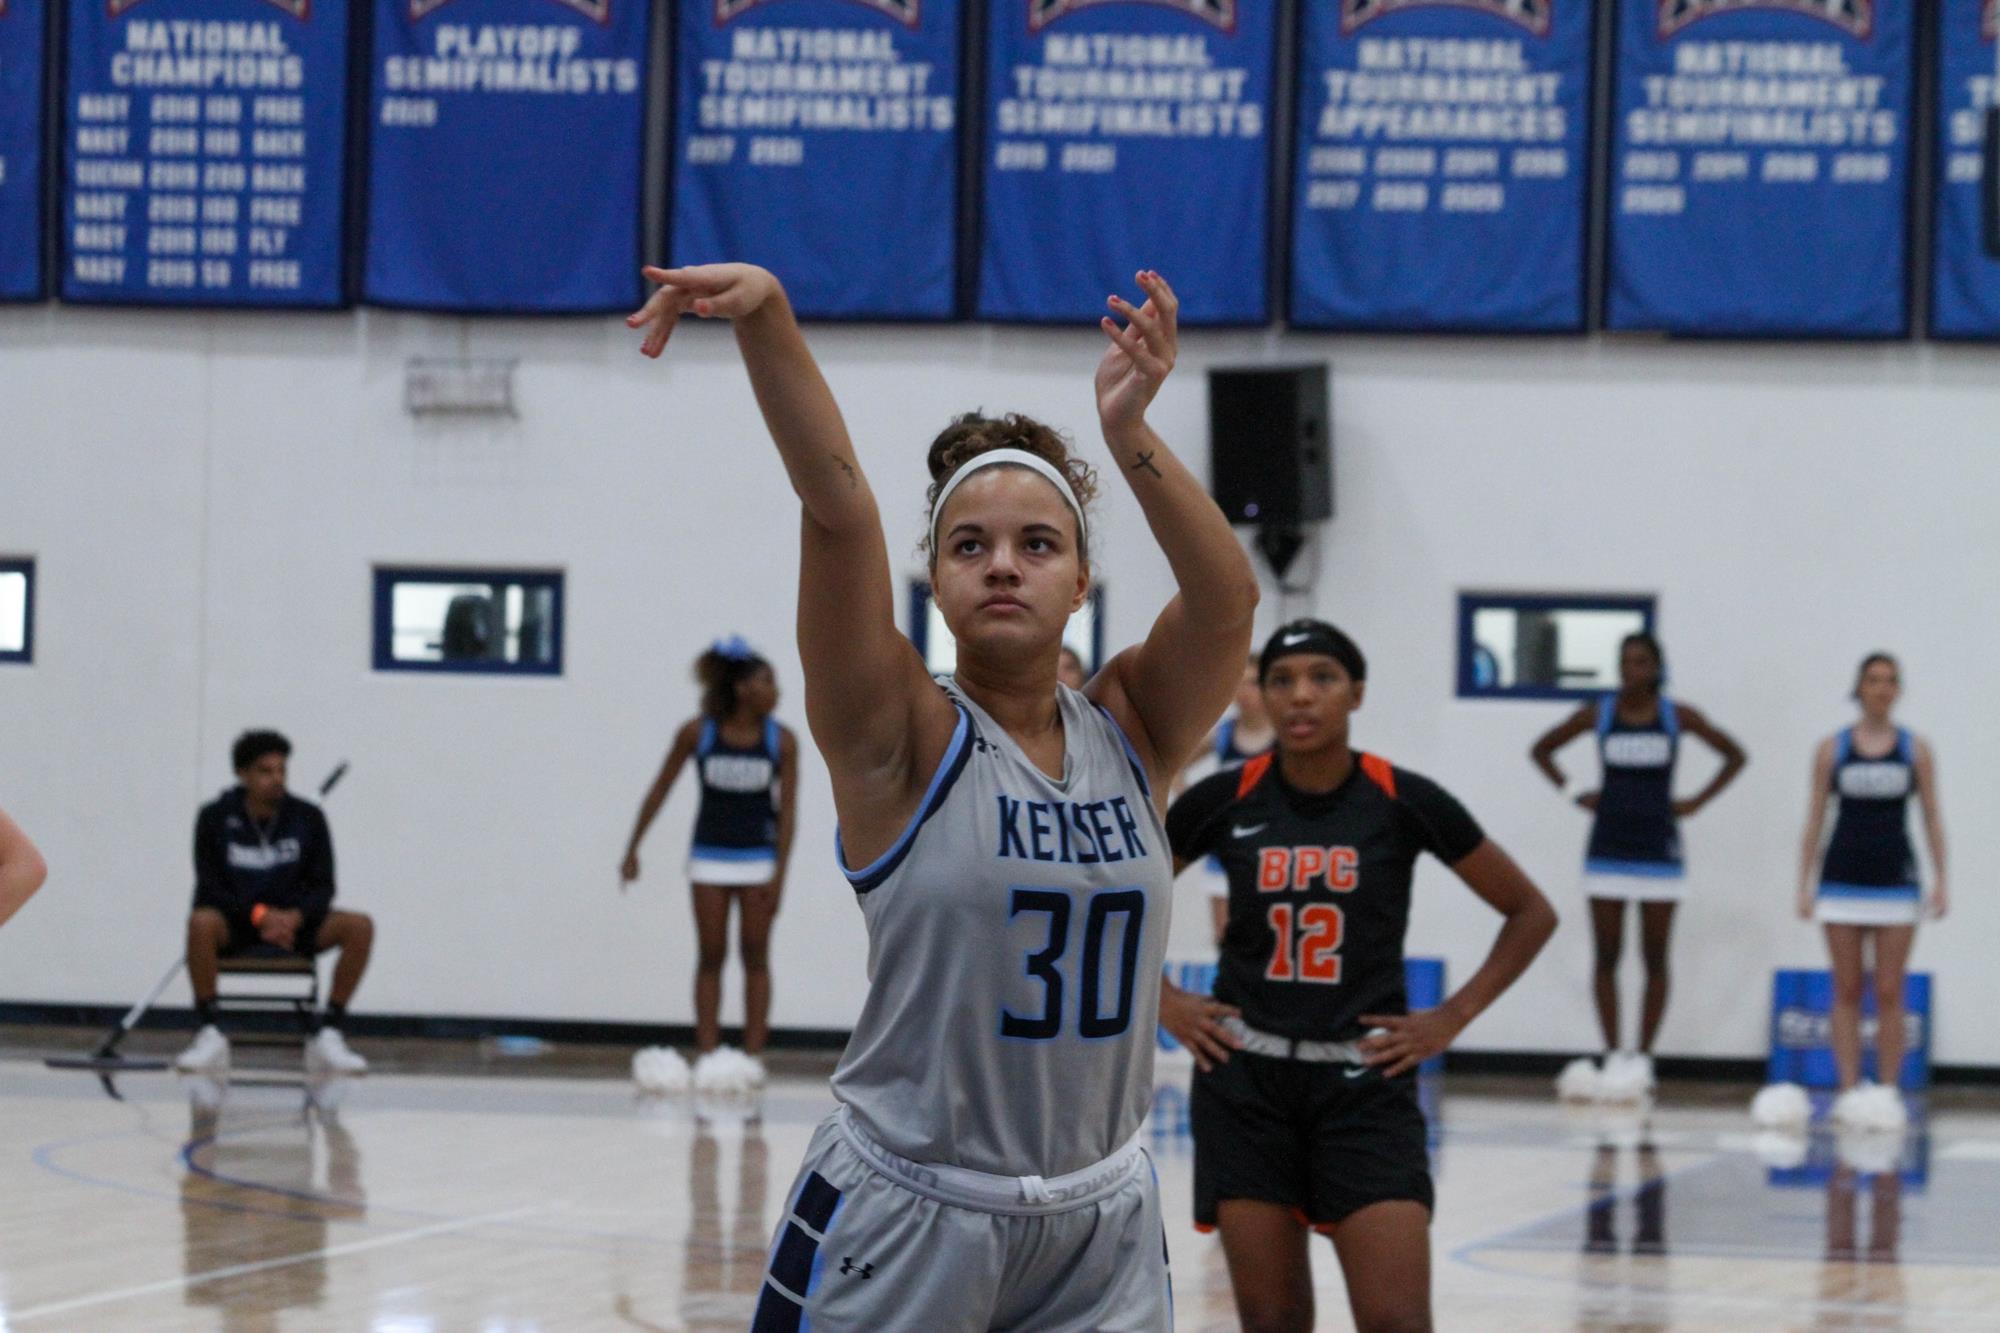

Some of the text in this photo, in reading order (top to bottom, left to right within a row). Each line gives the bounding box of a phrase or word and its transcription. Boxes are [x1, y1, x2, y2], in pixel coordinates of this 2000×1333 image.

[128, 22, 285, 53] NATIONAL
[437, 27, 579, 56] PLAYOFF
[733, 30, 897, 62] NATIONAL
[1045, 35, 1211, 67] NATIONAL
[112, 53, 302, 86] CHAMPIONS
[386, 54, 636, 90] SEMIFINALISTS
[1359, 39, 1527, 72] NATIONAL
[1676, 43, 1846, 75] NATIONAL
[704, 60, 930, 94] TOURNAMENT
[1016, 65, 1247, 100] TOURNAMENT
[1325, 69, 1561, 102] TOURNAMENT
[1645, 75, 1884, 107] TOURNAMENT
[702, 94, 953, 128] SEMIFINALISTS
[999, 99, 1260, 134] SEMIFINALISTS
[1628, 107, 1895, 143] SEMIFINALISTS
[998, 796, 1147, 863] KEISER
[1257, 846, 1358, 892] BPC
[1265, 902, 1346, 984] 12
[1001, 888, 1145, 1040] 30
